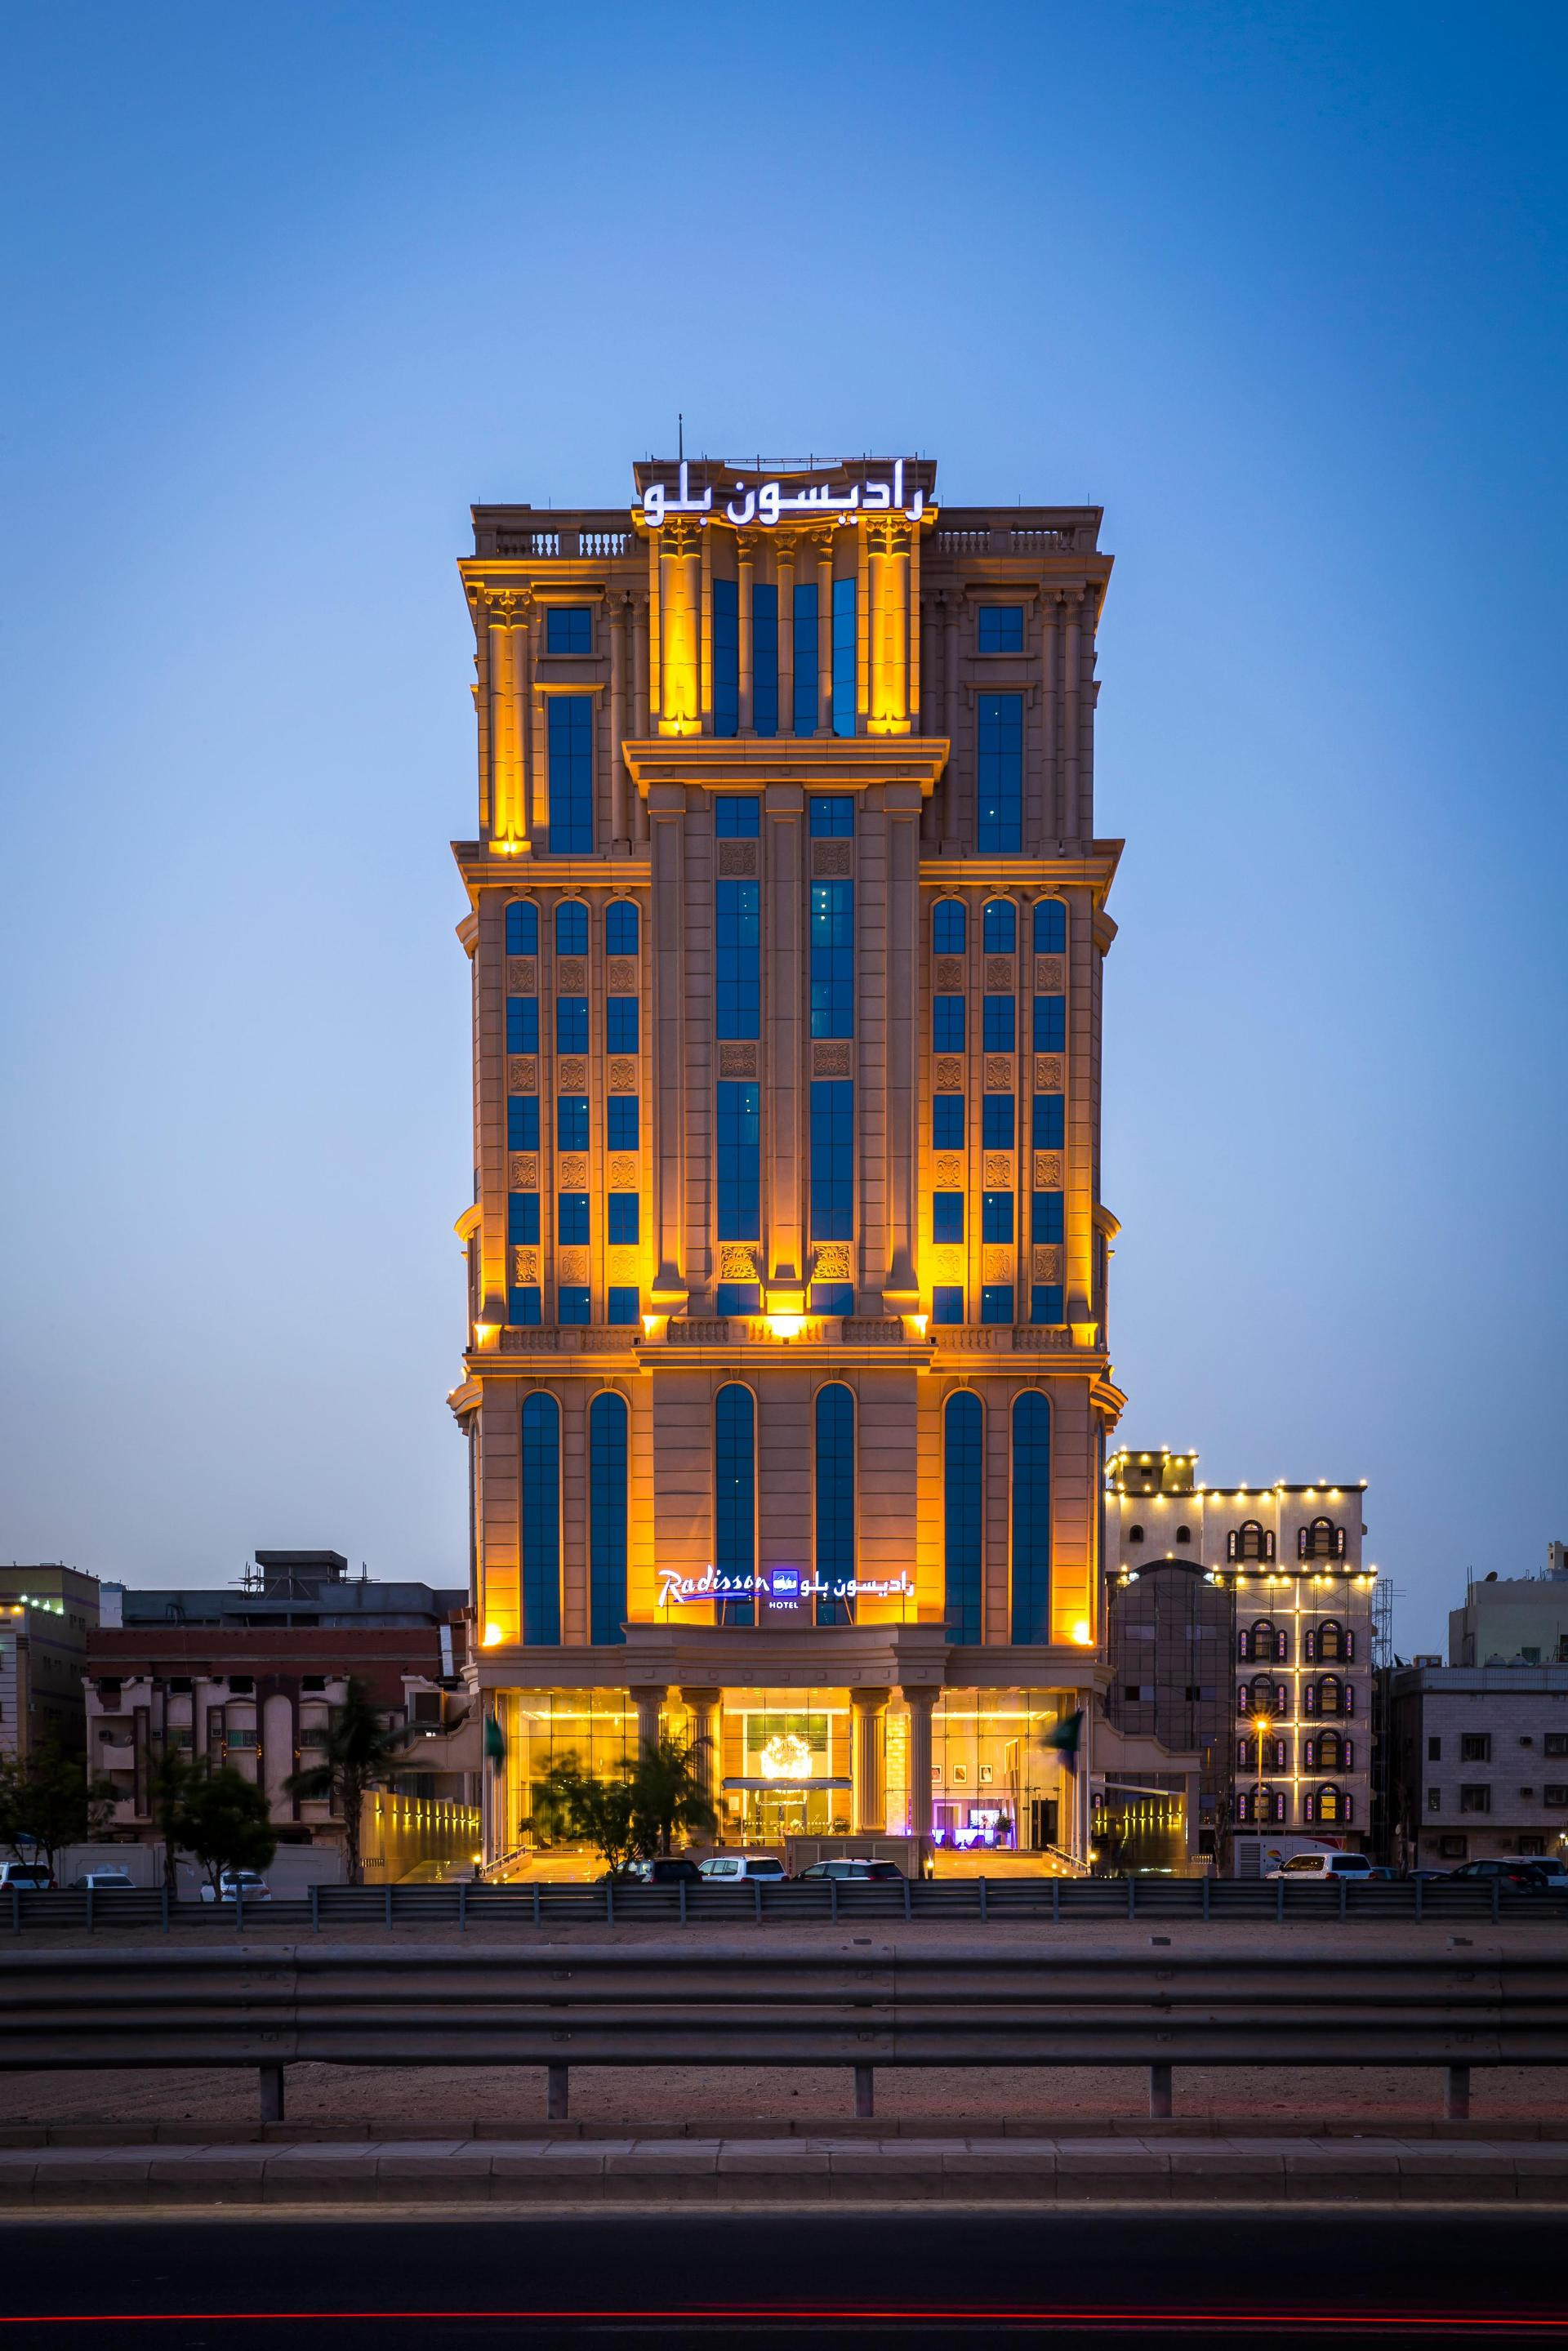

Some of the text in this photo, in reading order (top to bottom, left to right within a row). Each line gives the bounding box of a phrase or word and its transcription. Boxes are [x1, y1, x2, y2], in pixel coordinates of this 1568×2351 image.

[644, 457, 923, 528] راديسون بلو
[657, 1564, 770, 1607] Radisson
[800, 1570, 915, 1597] راديسون بلو
[768, 1601, 799, 1610] HOTEL
